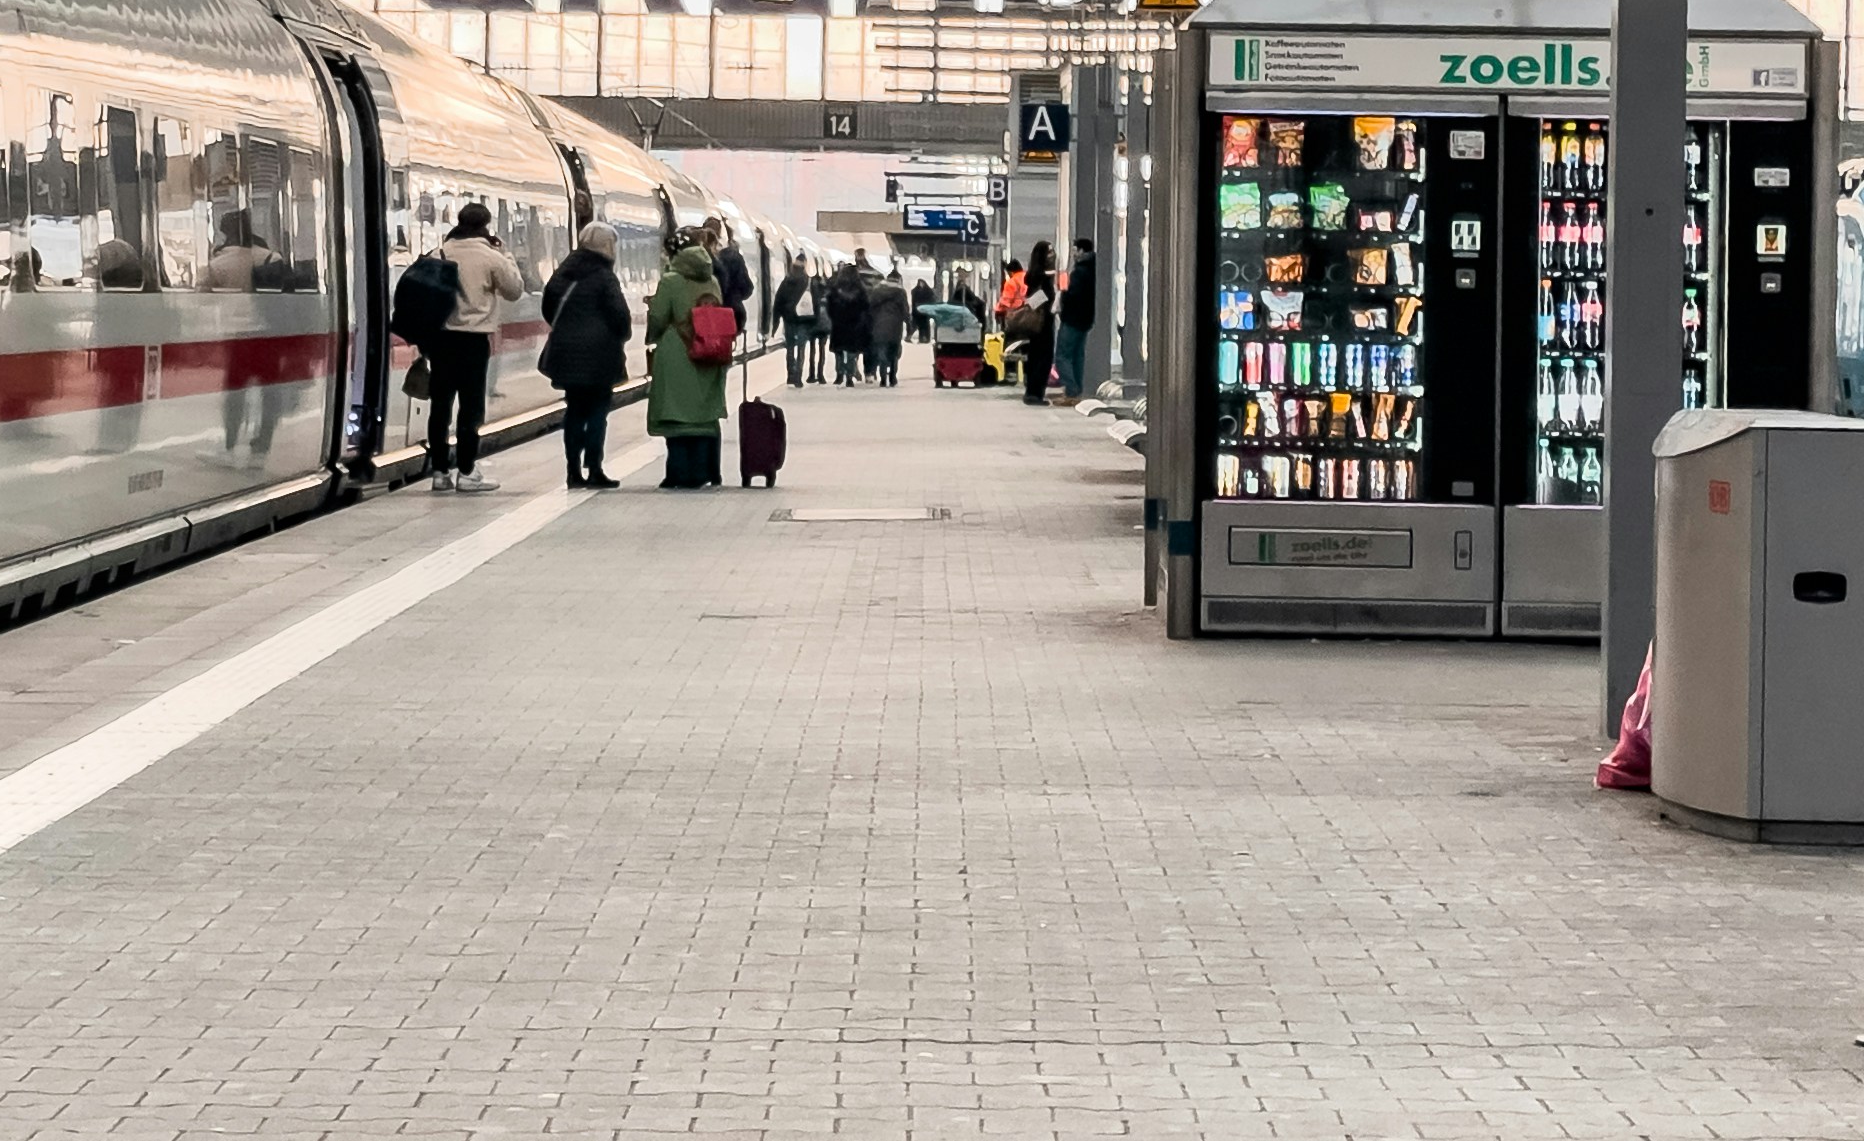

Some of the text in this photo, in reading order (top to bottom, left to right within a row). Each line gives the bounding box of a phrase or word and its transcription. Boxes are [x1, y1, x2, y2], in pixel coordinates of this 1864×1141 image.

[1699, 46, 1709, 87] GmbH
[830, 115, 851, 136] 14
[1028, 105, 1056, 141] A
[990, 178, 1006, 201] B
